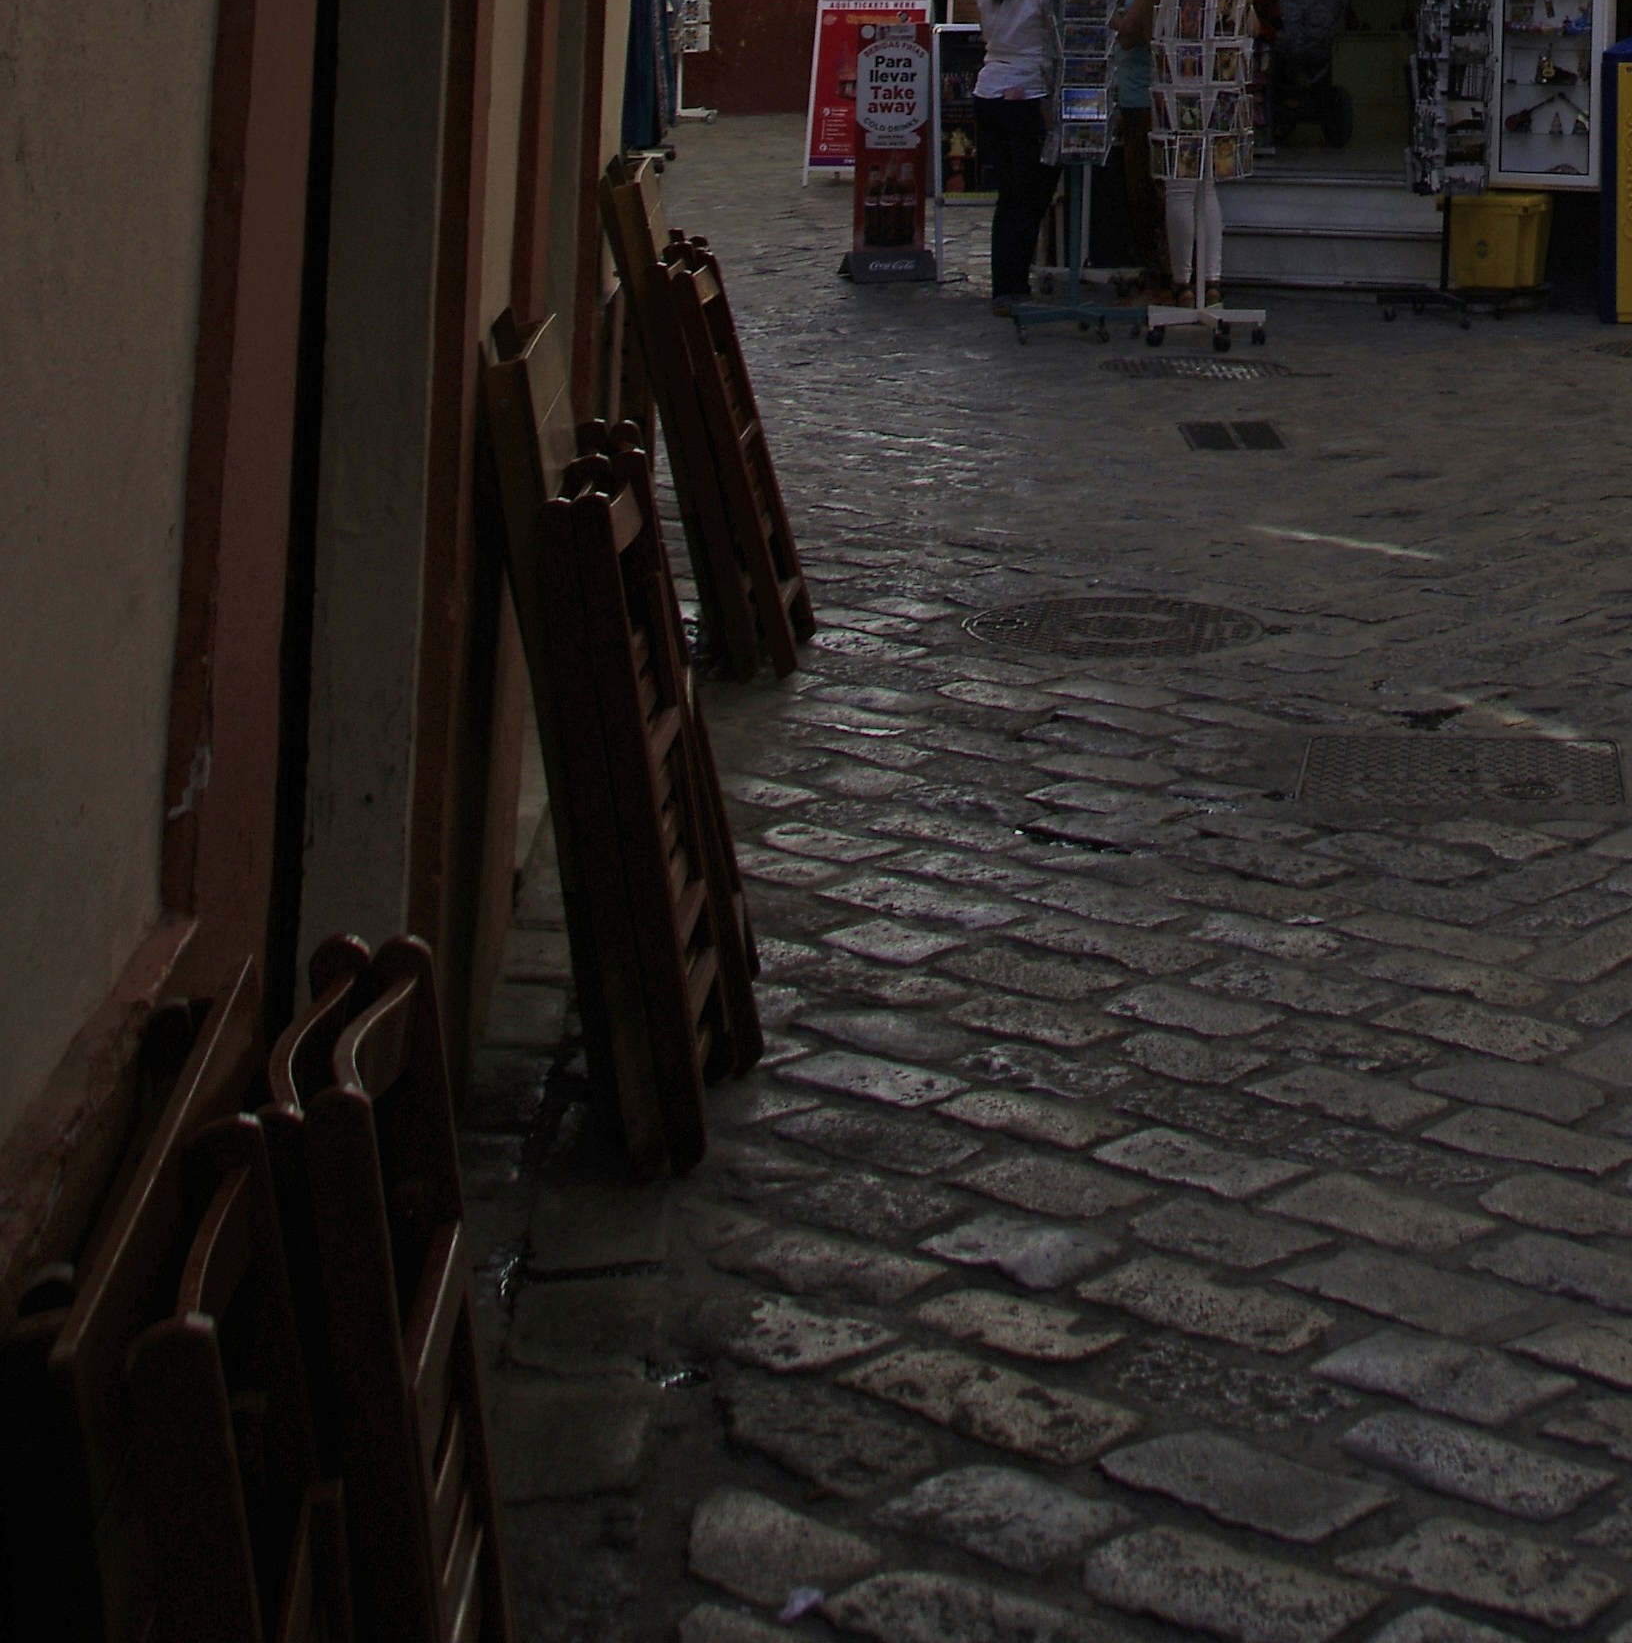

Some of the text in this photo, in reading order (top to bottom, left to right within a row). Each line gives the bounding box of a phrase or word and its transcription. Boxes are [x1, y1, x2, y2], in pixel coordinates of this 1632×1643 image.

[854, 1, 889, 9] TICKETS
[893, 1, 916, 9] HERE
[864, 42, 900, 58] BEBIDAS
[875, 56, 912, 68] Para
[869, 69, 917, 83] llevar
[870, 86, 915, 100] Take
[867, 102, 916, 116] away
[863, 117, 919, 133] COLD DRINKS
